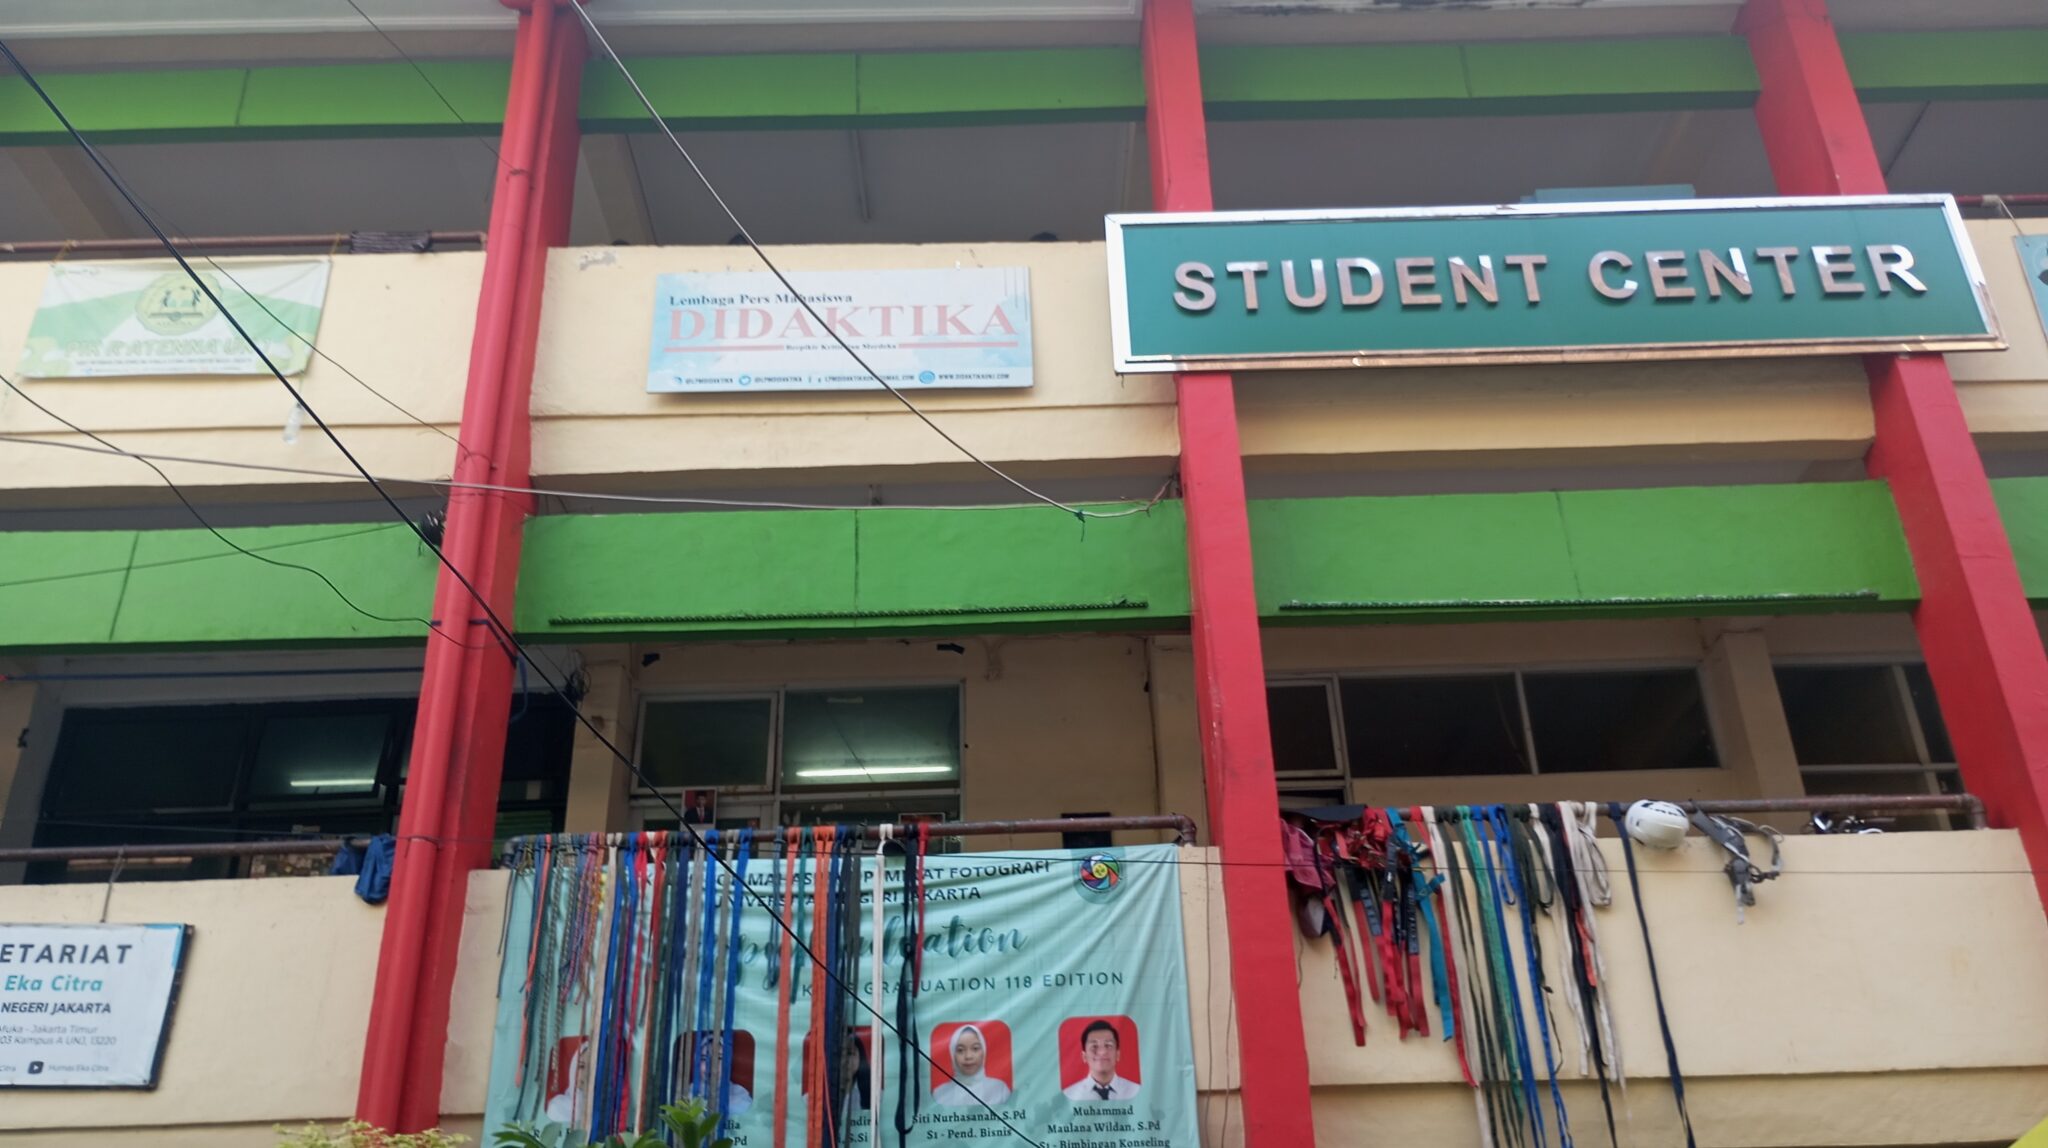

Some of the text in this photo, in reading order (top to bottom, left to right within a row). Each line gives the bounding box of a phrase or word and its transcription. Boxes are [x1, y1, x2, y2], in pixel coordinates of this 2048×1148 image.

[1173, 244, 1928, 312] STUDENT CENTER
[670, 295, 734, 306] Lembaga
[740, 294, 770, 304] Pers
[669, 304, 1020, 341] DIDAKTIKA
[950, 860, 1049, 879] FOTOGRAFI
[0, 944, 132, 964] ETARIAT
[4, 974, 103, 992] Eka Citra
[1006, 975, 1033, 989] 118
[1043, 971, 1123, 988] EDITION
[1, 1002, 111, 1015] NEGERI JAKARTA
[32, 1025, 67, 1034] Jakarta
[70, 1025, 98, 1034] Timur
[1003, 1109, 1026, 1121] S.Pd
[1073, 1105, 1134, 1117] Muhammad
[948, 1127, 977, 1140] Pend.
[980, 1126, 1012, 1138] Bisnis
[1048, 1120, 1160, 1134] Maulana Wildan, S.Pd
[1119, 1138, 1171, 1148] Konseling
